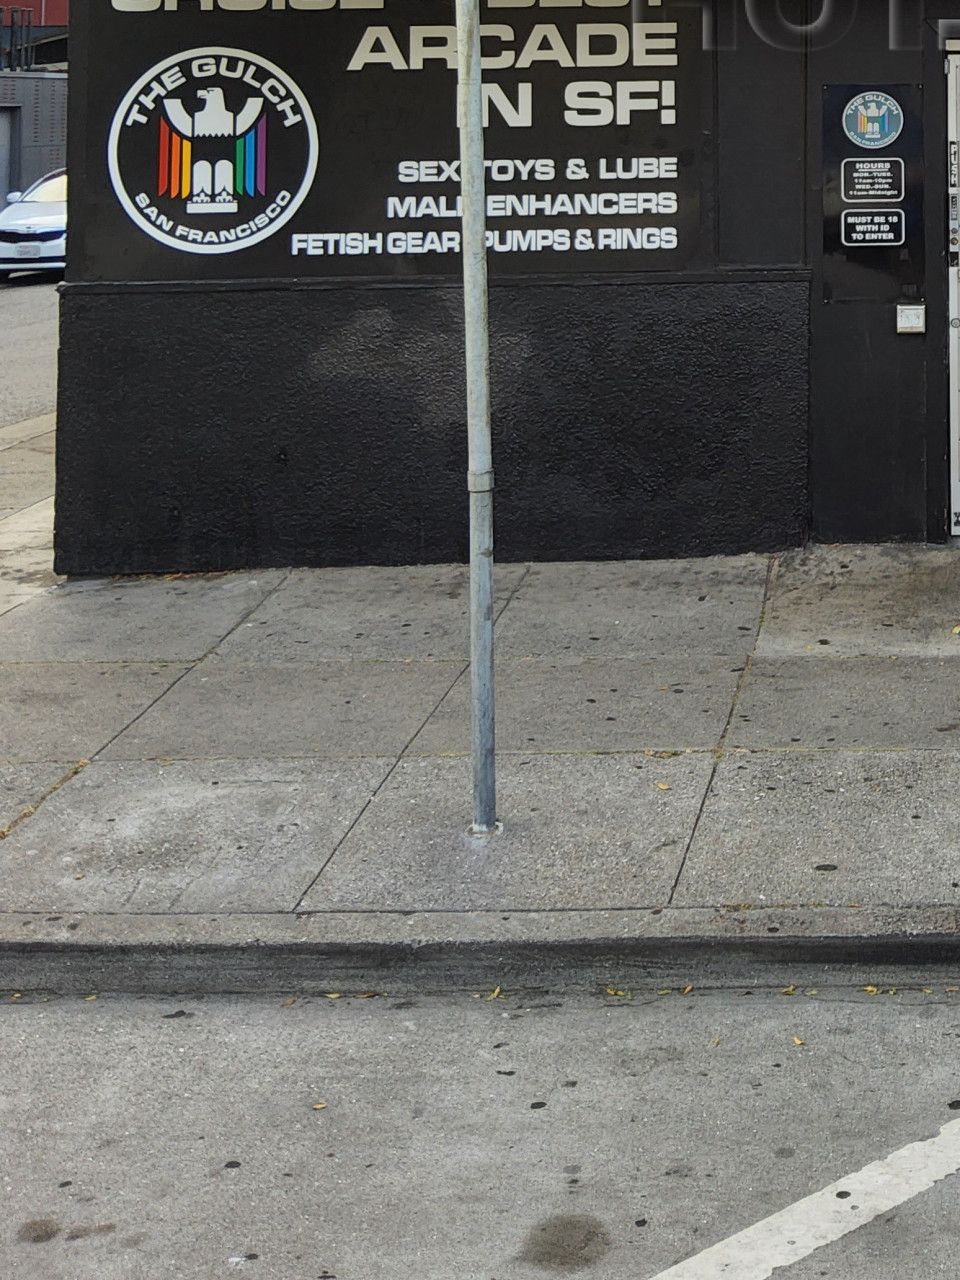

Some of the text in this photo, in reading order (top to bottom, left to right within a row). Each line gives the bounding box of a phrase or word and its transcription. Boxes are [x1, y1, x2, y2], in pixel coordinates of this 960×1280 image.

[347, 23, 678, 70] ARCADE
[125, 57, 303, 128] THE GULCH
[563, 81, 676, 126] SF!
[846, 94, 899, 115] THE GULCH
[398, 160, 461, 183] SEX
[565, 158, 590, 181] &
[599, 157, 678, 180] LUBE
[950, 144, 958, 185] PUSH
[135, 190, 291, 243] SAN FRANCISCO
[487, 192, 678, 216] ENHANCERS
[291, 232, 383, 256] FETISH
[387, 231, 460, 254] GEAR
[574, 228, 595, 251] &
[598, 227, 678, 251] RINGS
[865, 232, 895, 240] ENTER
